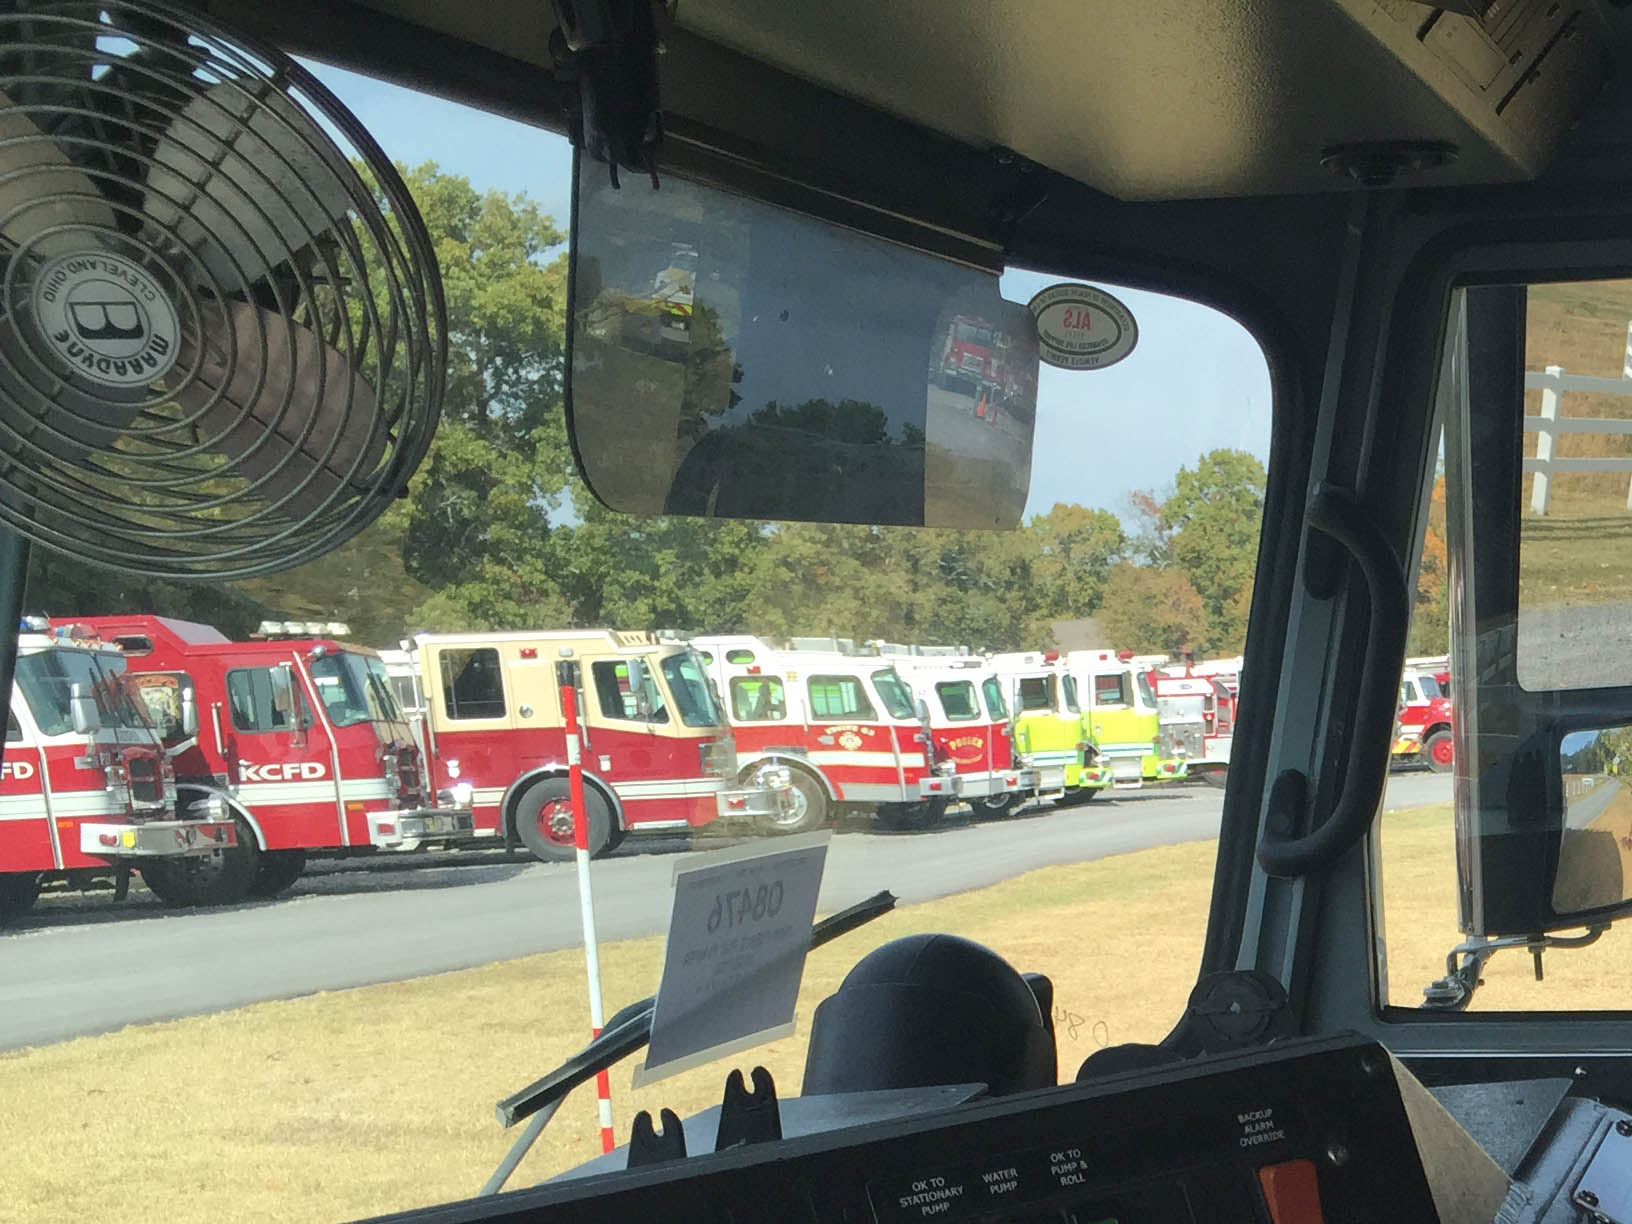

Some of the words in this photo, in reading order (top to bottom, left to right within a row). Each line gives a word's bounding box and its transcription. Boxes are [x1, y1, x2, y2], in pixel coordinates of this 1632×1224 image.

[43, 271, 67, 303] OHIO
[53, 329, 169, 377] MARADYNE
[239, 760, 326, 783] KCFD
[1237, 1108, 1273, 1124] BACKUP
[1244, 1120, 1275, 1134] ALARM
[1239, 1129, 1286, 1148] OVERRIDE
[1050, 1151, 1066, 1163] OK
[1067, 1148, 1081, 1160] TO
[981, 1168, 1018, 1184] WATER
[1051, 1162, 1078, 1176] PUMP
[912, 1180, 929, 1193] OK
[931, 1177, 945, 1189] TO
[990, 1180, 1018, 1195] PUMP
[1060, 1172, 1087, 1187] ROLL
[899, 1185, 964, 1208] STATIONARY
[921, 1202, 951, 1216] PUMP
